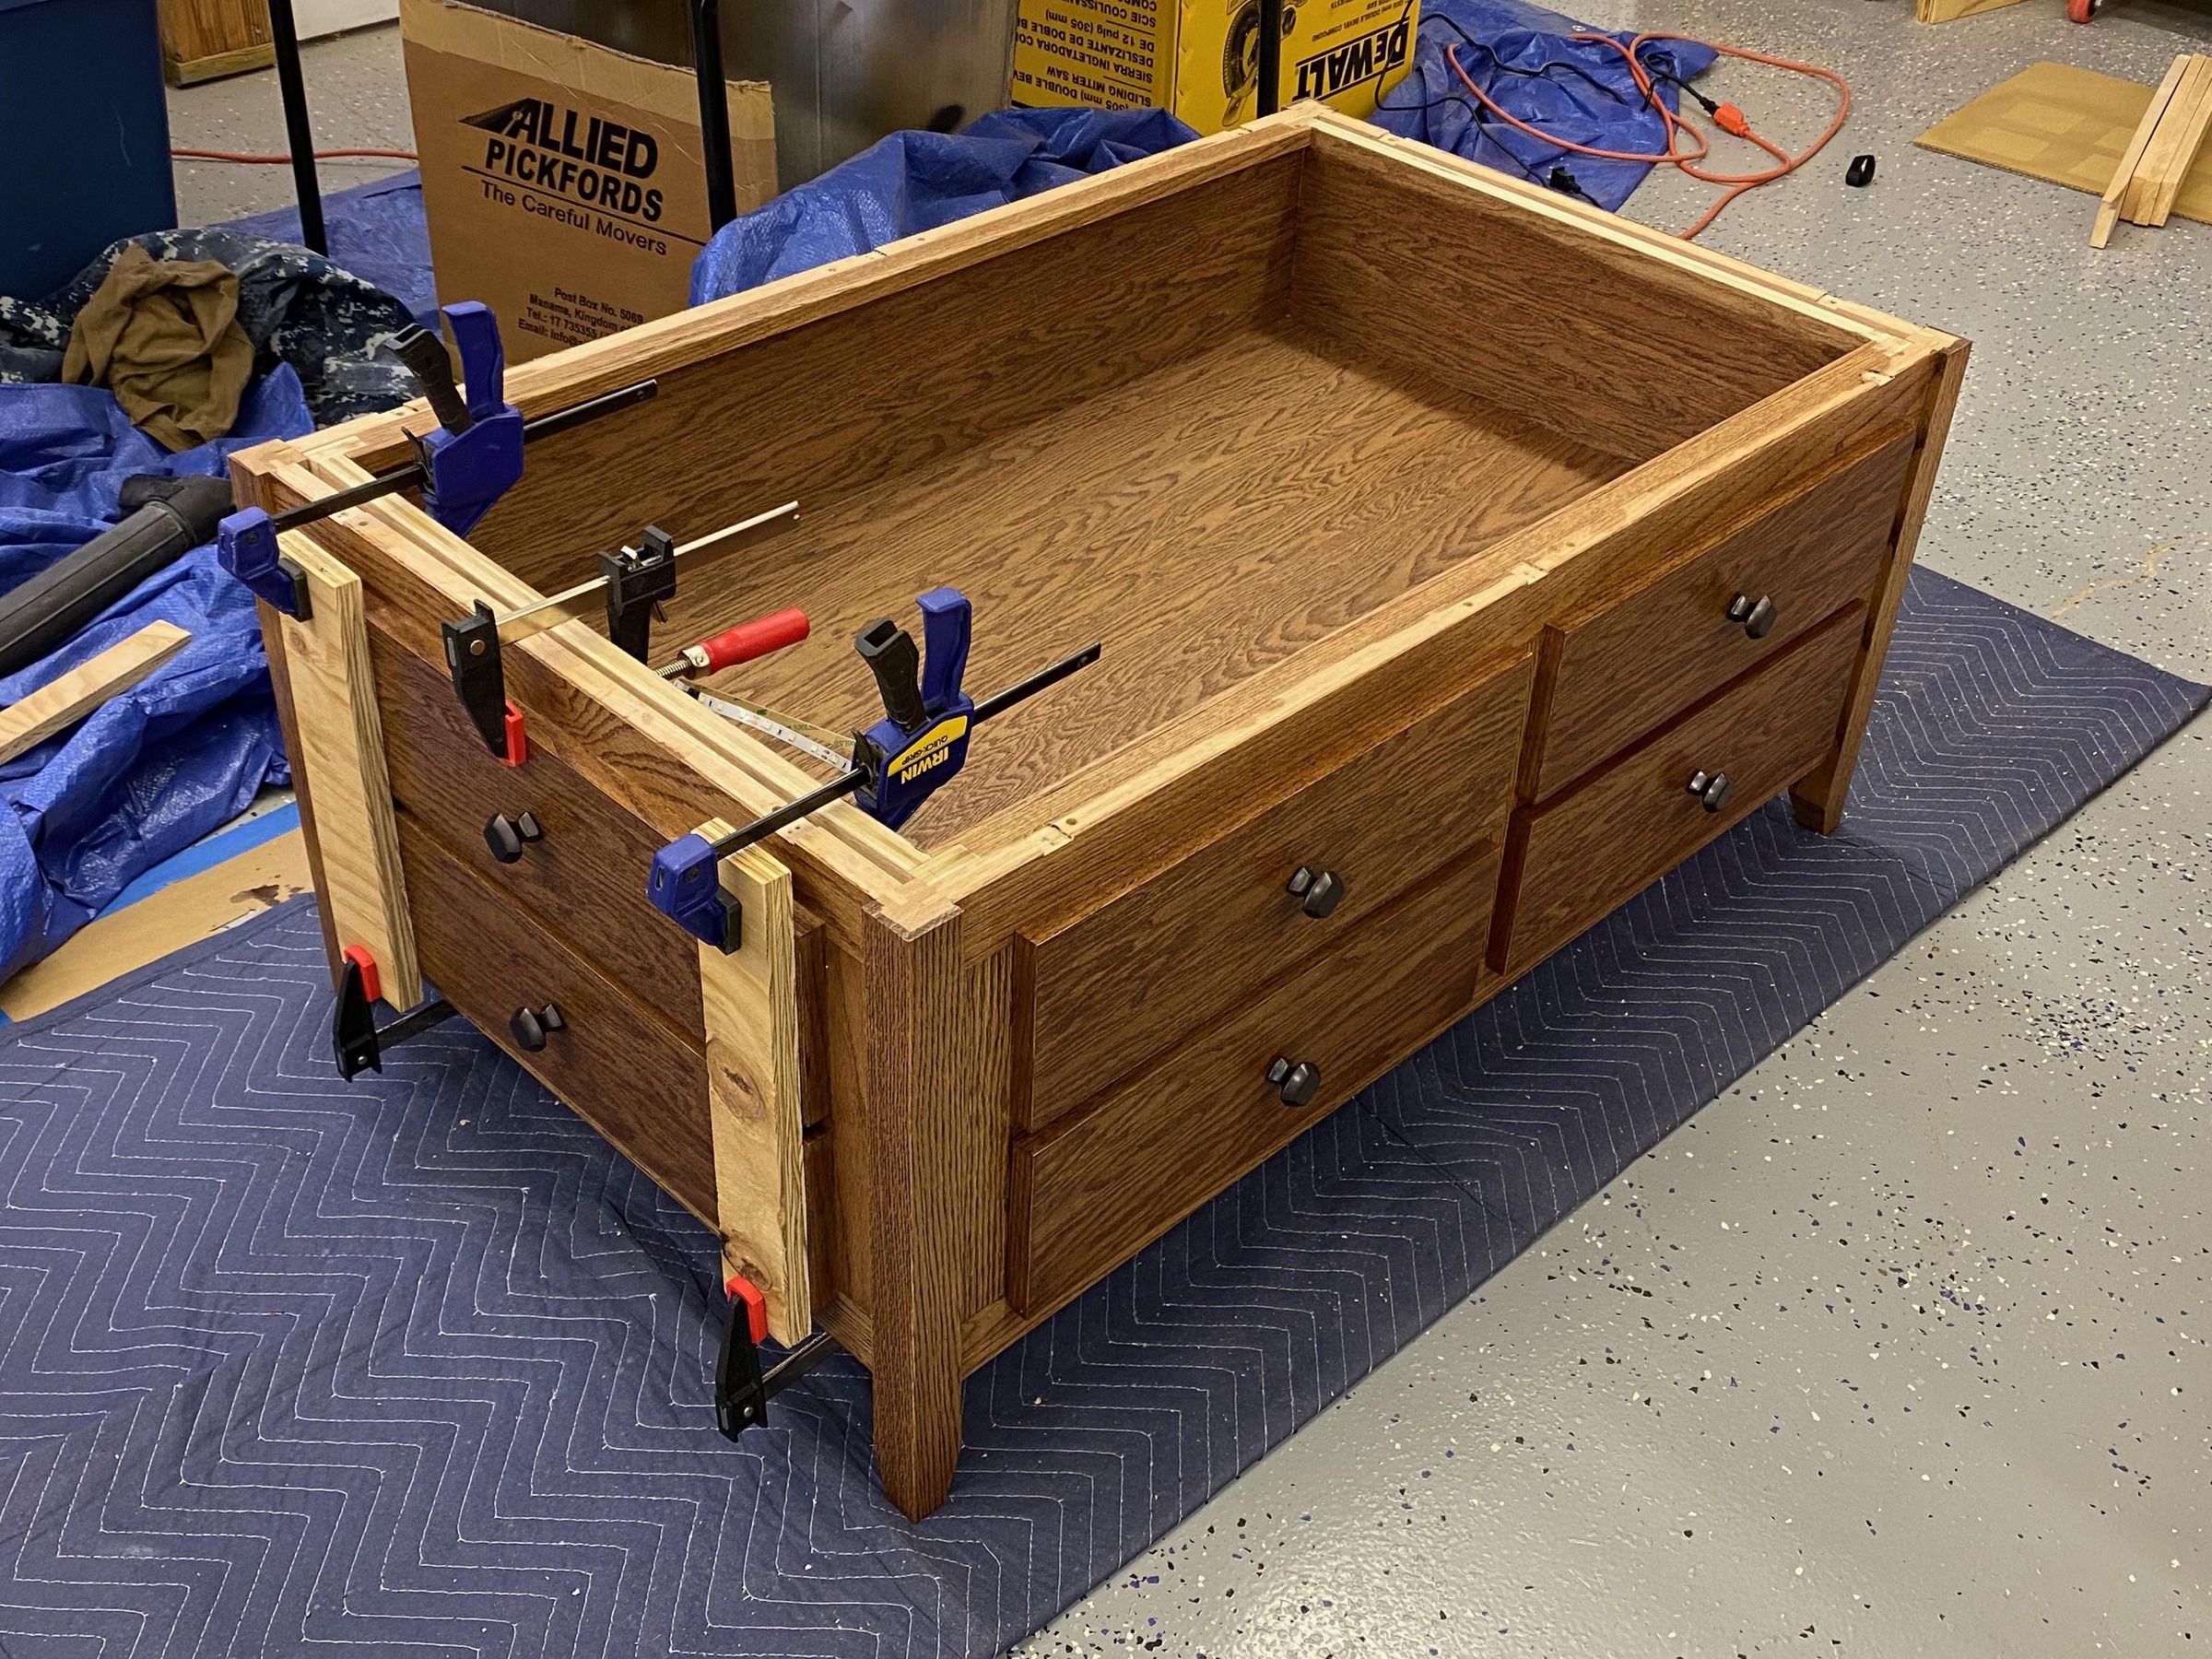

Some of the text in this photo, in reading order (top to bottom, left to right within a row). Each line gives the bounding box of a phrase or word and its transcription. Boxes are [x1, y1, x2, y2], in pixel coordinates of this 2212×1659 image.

[1032, 22, 1065, 41] DOBLE
[1046, 9, 1154, 53] DE 12 pulg (305 mm)
[1131, 12, 1156, 28] SCIE
[1037, 39, 1110, 70] INGLETADORA
[1070, 34, 1083, 46] DE
[1088, 39, 1153, 67] DESLIZANTE
[1113, 63, 1152, 83] SIERRA
[1292, 23, 1408, 101] DEWALT
[1036, 76, 1077, 99] DOUBLE
[1047, 66, 1151, 107] SLIDING MITER SAW
[1080, 89, 1102, 104] mm)
[502, 98, 659, 179] ALLIED
[485, 137, 664, 221] PICKFORDS
[481, 180, 667, 256] The Careful Movers
[530, 294, 571, 318] Manama,
[574, 308, 618, 332] Kingdom
[554, 287, 643, 324] Post Box No. 5069
[518, 318, 547, 335] Email:
[548, 315, 561, 328] 17
[564, 318, 597, 338] 735355
[901, 747, 948, 784] IRWIN
